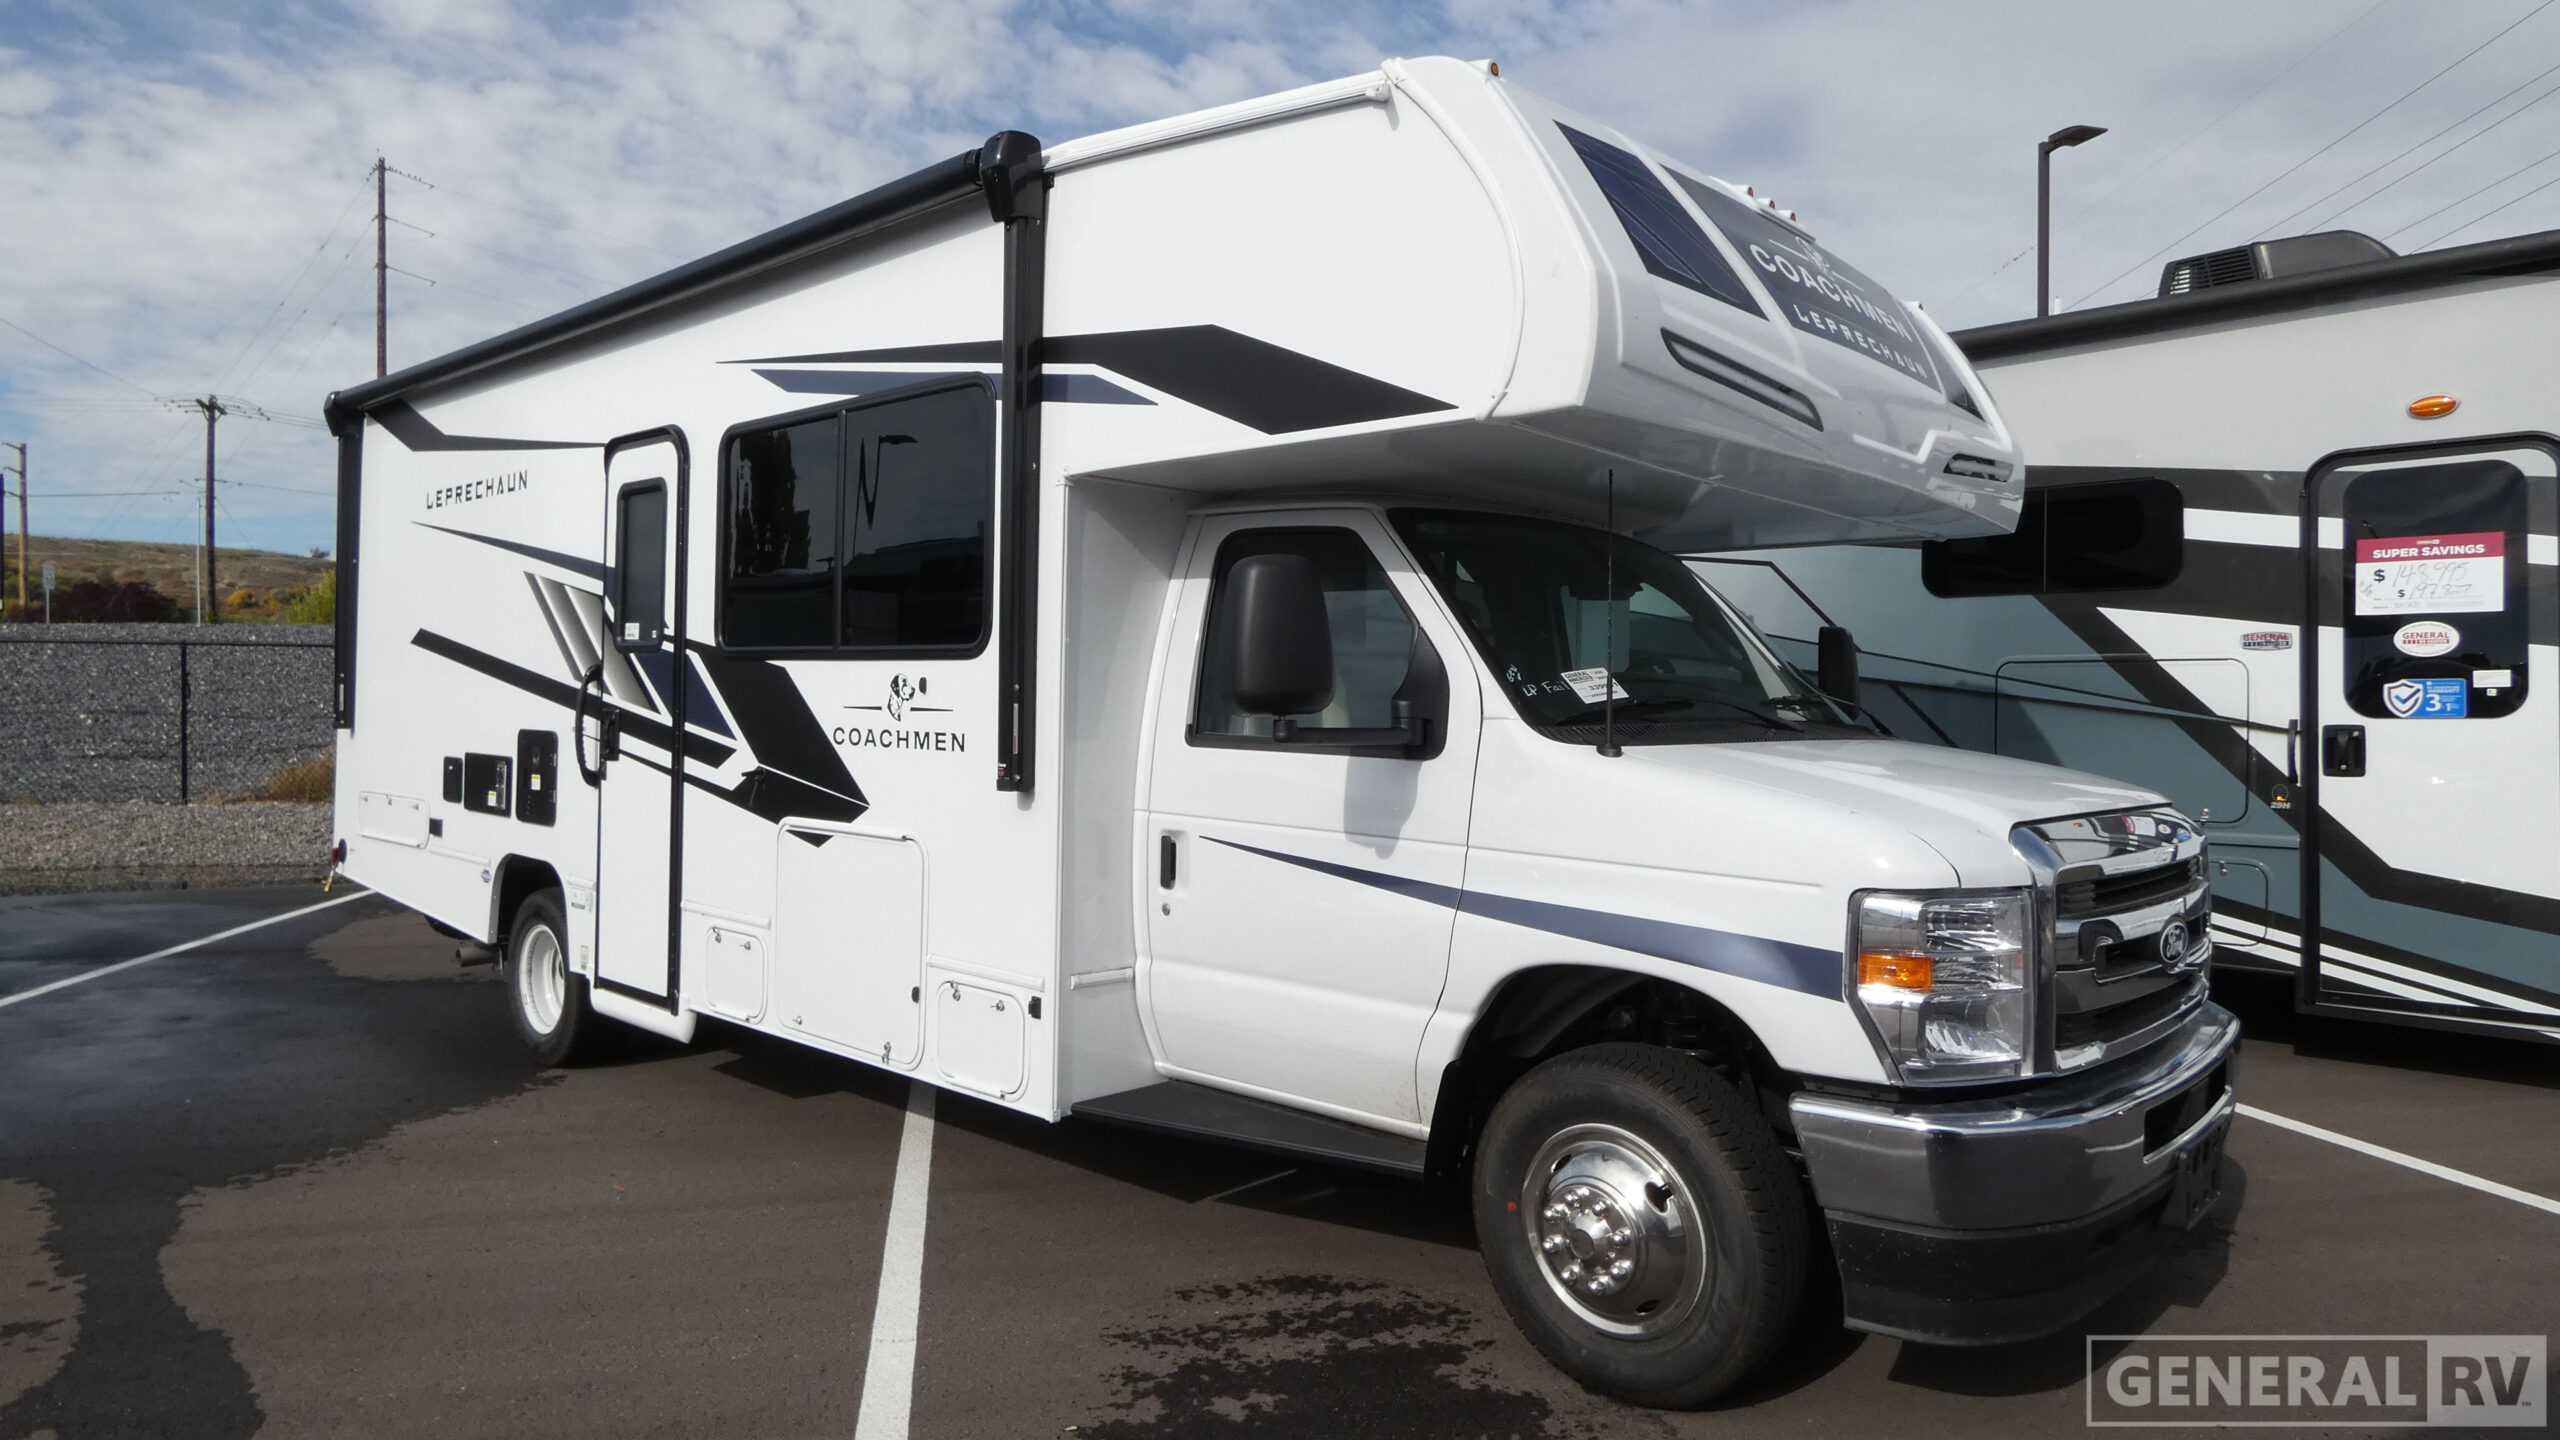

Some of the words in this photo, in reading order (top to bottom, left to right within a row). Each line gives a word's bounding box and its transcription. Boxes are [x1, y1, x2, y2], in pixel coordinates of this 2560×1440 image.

[1749, 243, 1913, 343] COACHMEN
[1793, 304, 1928, 379] LEPRECHAUN
[426, 469, 528, 510] LEPRECHAUN
[2373, 548, 2418, 558] SUPER
[2422, 544, 2485, 556] SAVINGS
[2373, 568, 2386, 584] $
[2397, 589, 2406, 598] $
[2243, 633, 2289, 641] GENERAL
[2425, 693, 2442, 712] 3
[832, 726, 966, 753] COACHMEN
